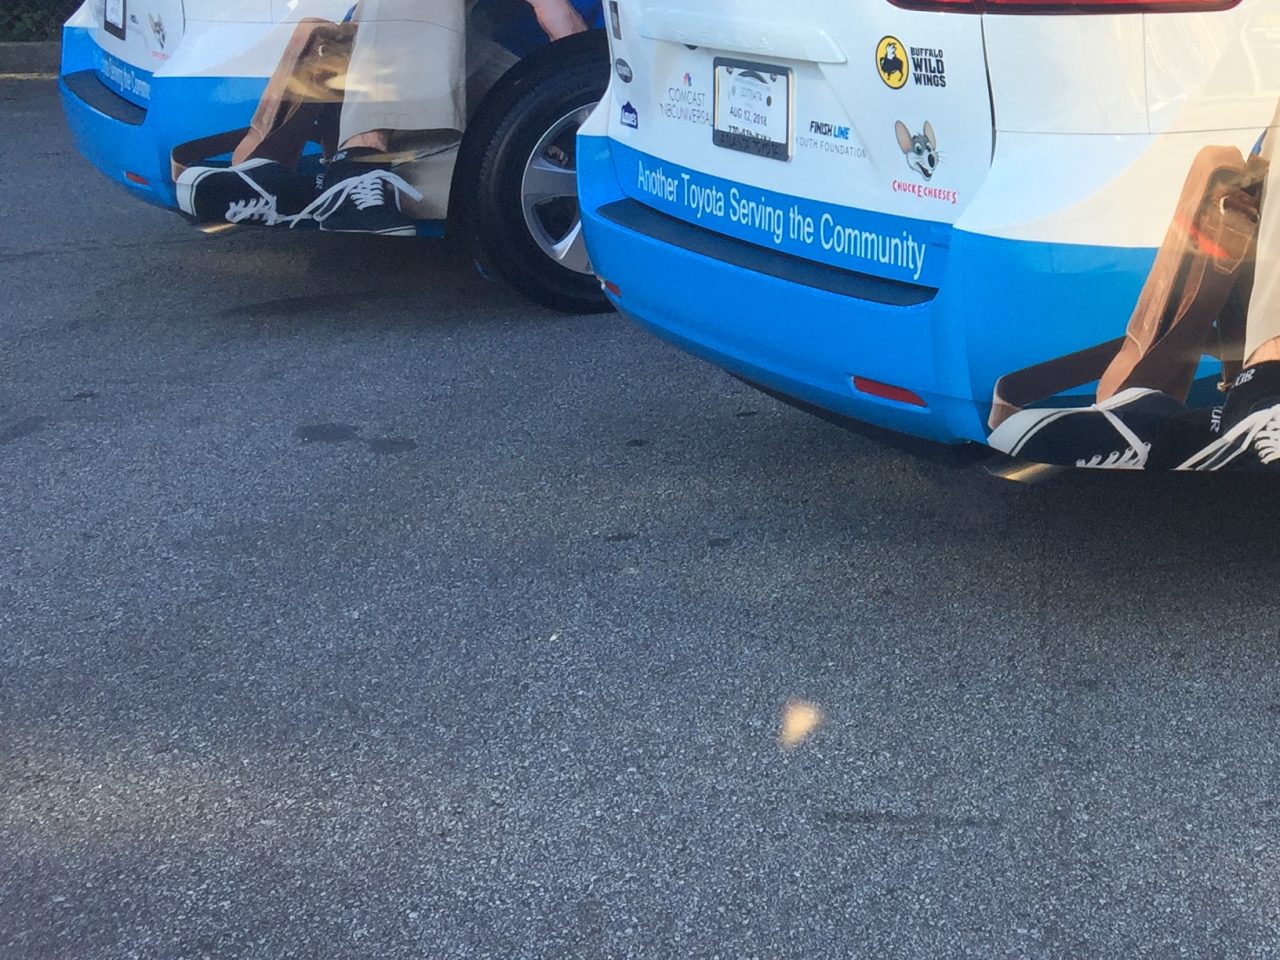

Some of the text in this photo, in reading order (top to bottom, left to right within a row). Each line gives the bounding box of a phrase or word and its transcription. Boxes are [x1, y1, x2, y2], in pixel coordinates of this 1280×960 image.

[910, 46, 943, 59] BUFFALO
[912, 57, 945, 74] WILD
[913, 72, 947, 88] WINGS
[668, 87, 706, 107] COMCAST
[810, 121, 850, 140] FINISH LINE
[820, 141, 867, 159] FOUNDATION
[892, 180, 917, 195] CHUCK
[638, 160, 926, 280] Another Toyota Serving the Community
